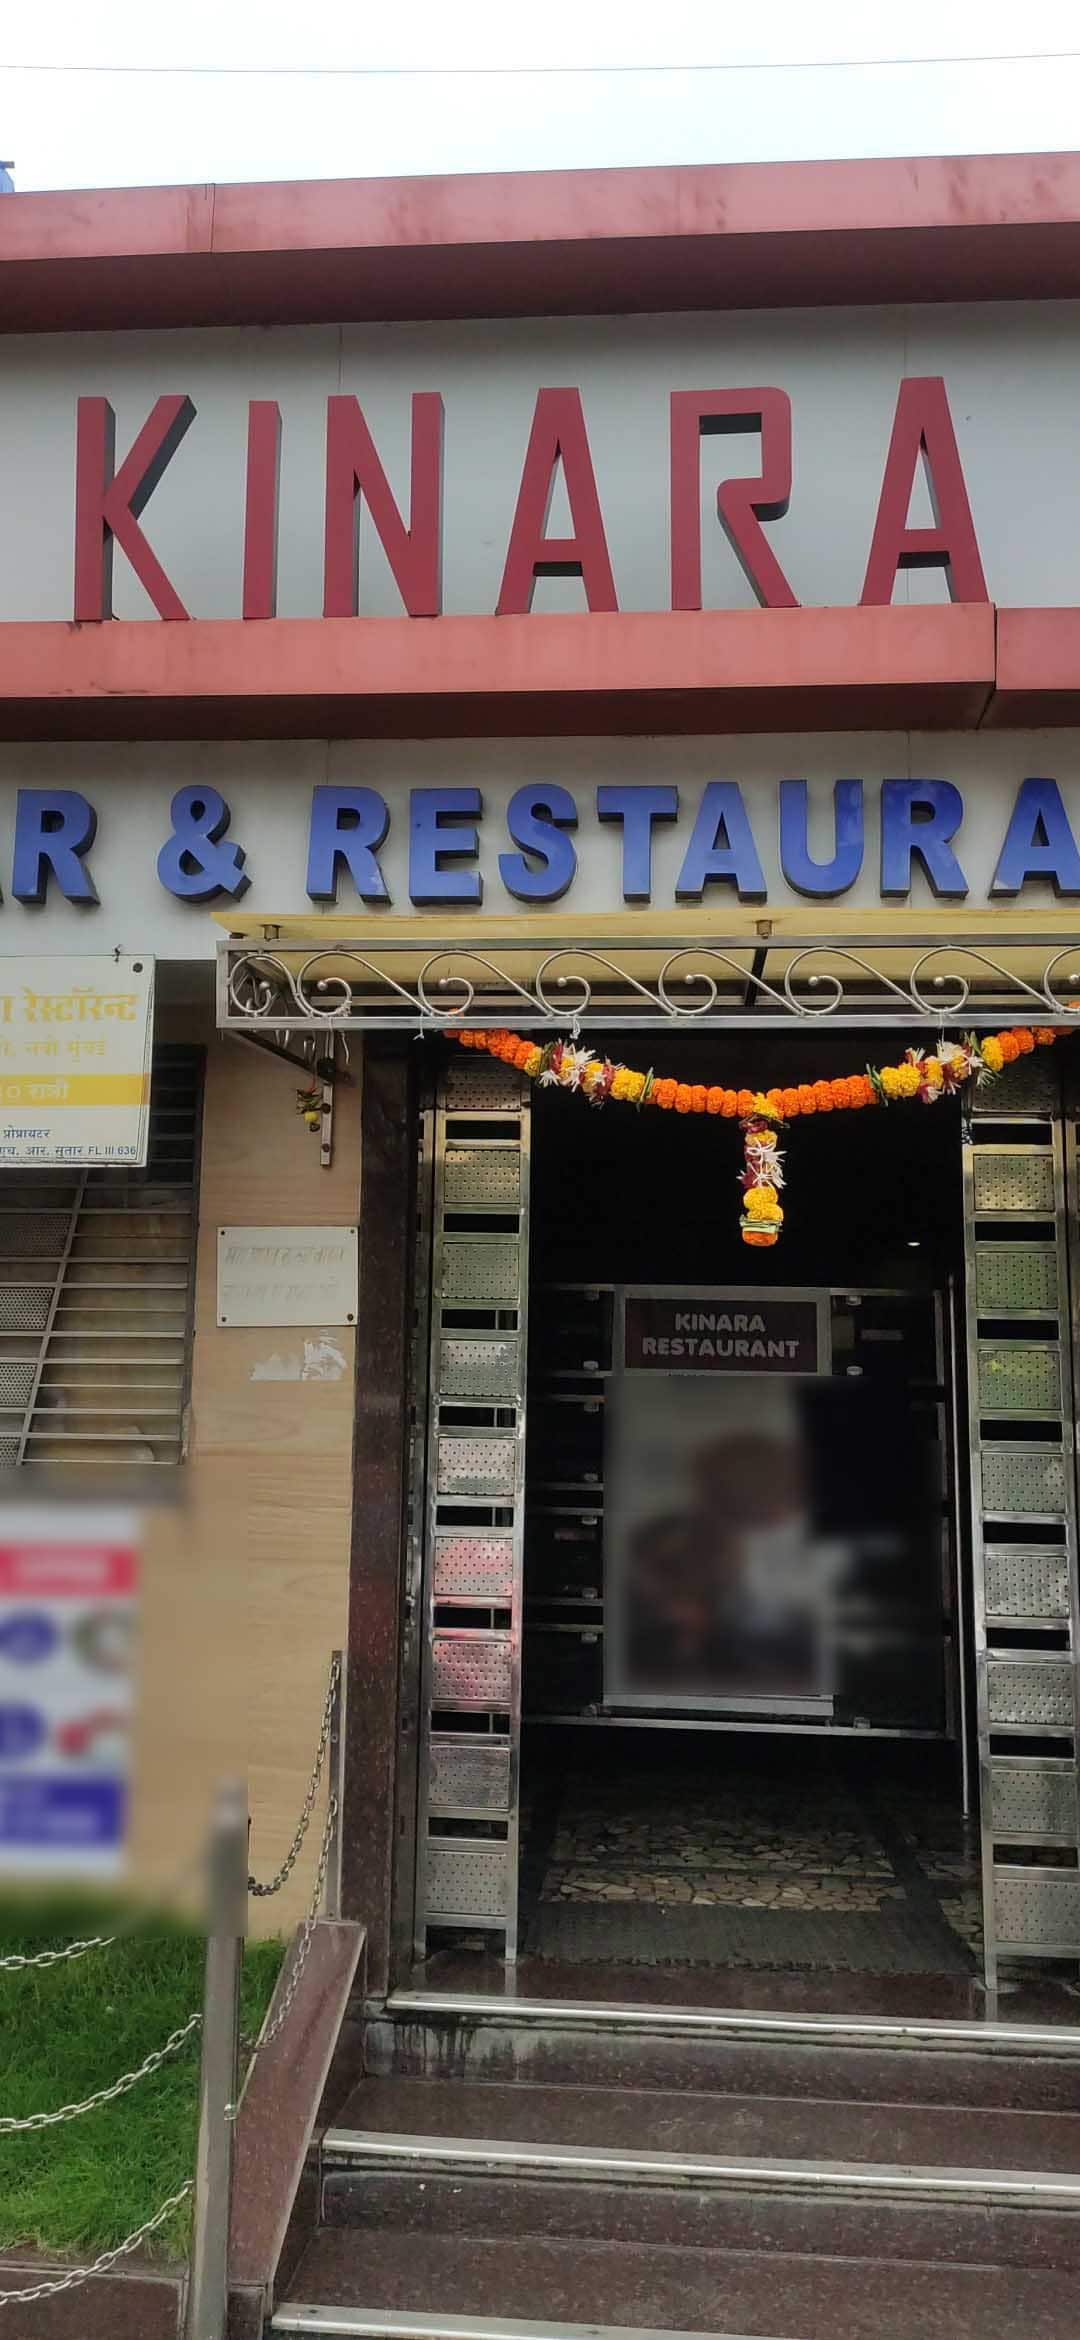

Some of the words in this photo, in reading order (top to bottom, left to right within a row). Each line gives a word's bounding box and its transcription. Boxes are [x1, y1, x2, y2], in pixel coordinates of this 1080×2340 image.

[74, 376, 990, 622] KINARA
[0, 787, 101, 905] R
[157, 784, 253, 904] &
[305, 777, 1080, 905] RESTAURA
[641, 1337, 800, 1359] RESTAURANT
[674, 1311, 766, 1333] KINARA
